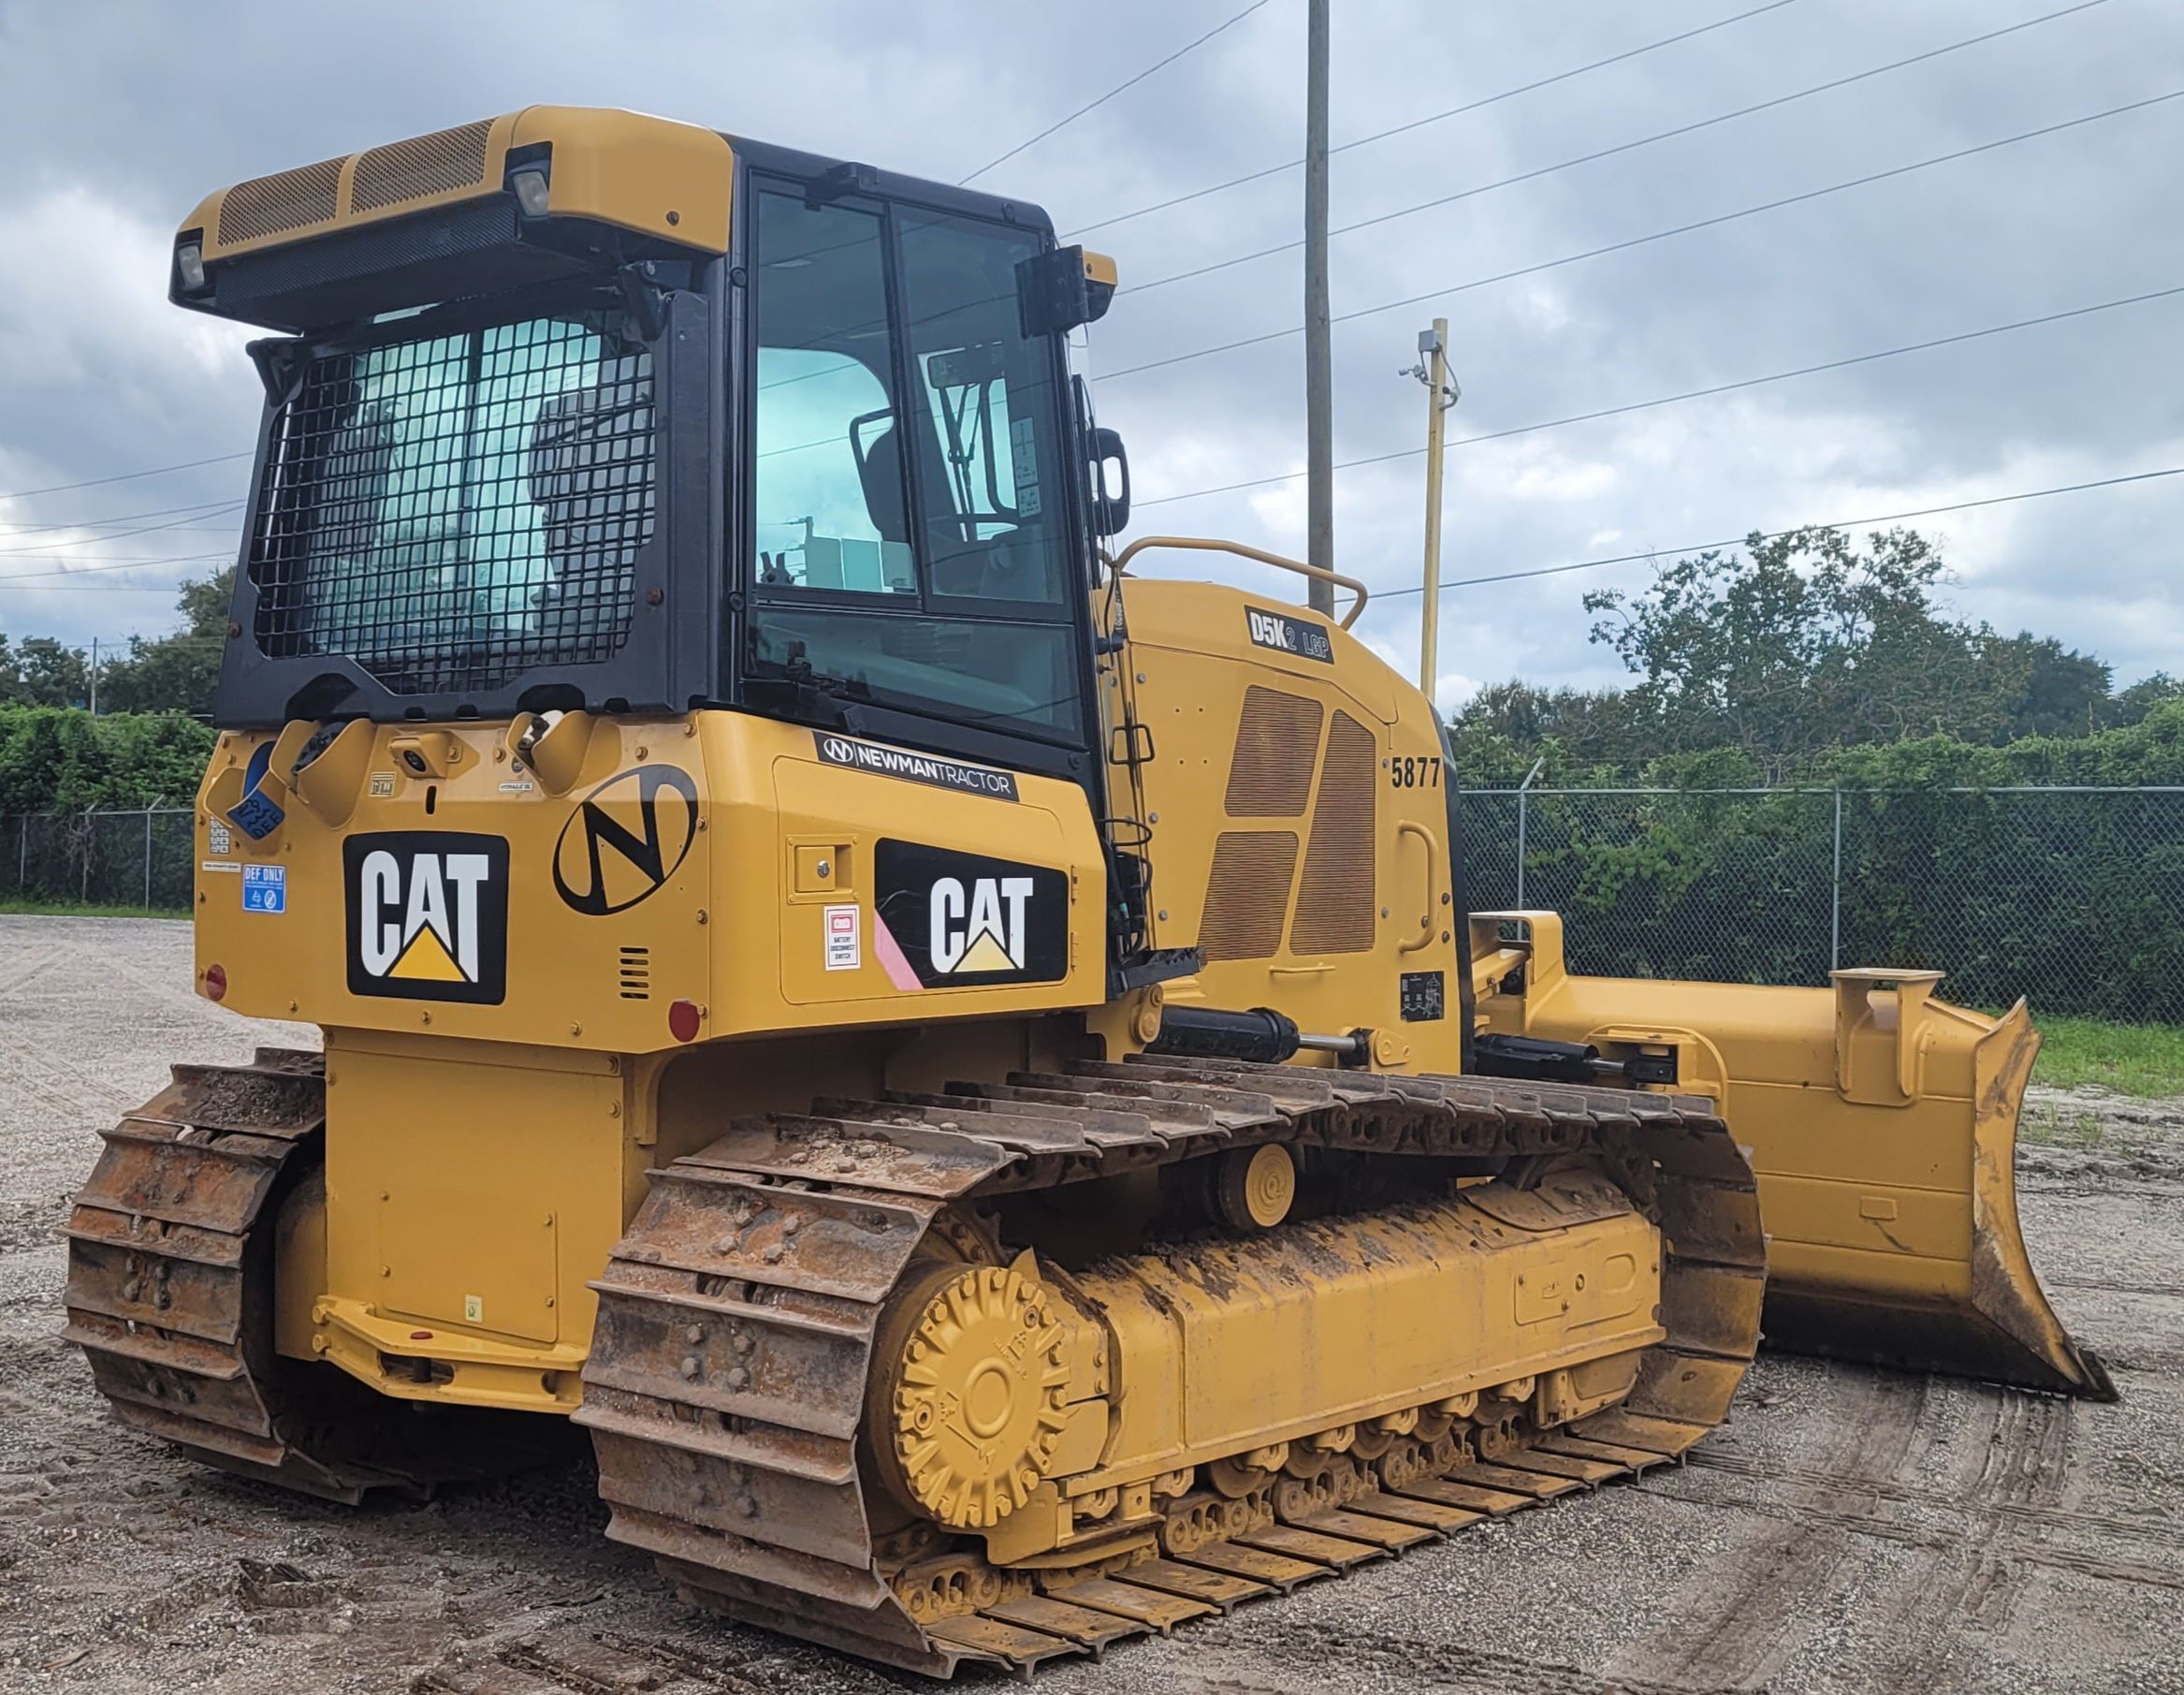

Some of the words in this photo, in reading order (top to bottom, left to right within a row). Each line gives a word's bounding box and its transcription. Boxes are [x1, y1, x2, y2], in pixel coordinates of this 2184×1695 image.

[1250, 611, 1297, 650] D5K2
[1303, 632, 1329, 658] LGP
[1391, 756, 1440, 788] 5877
[245, 867, 261, 880] DEF
[263, 868, 284, 882] ONLY
[361, 850, 488, 983] CAT
[930, 877, 1033, 973] CAT
